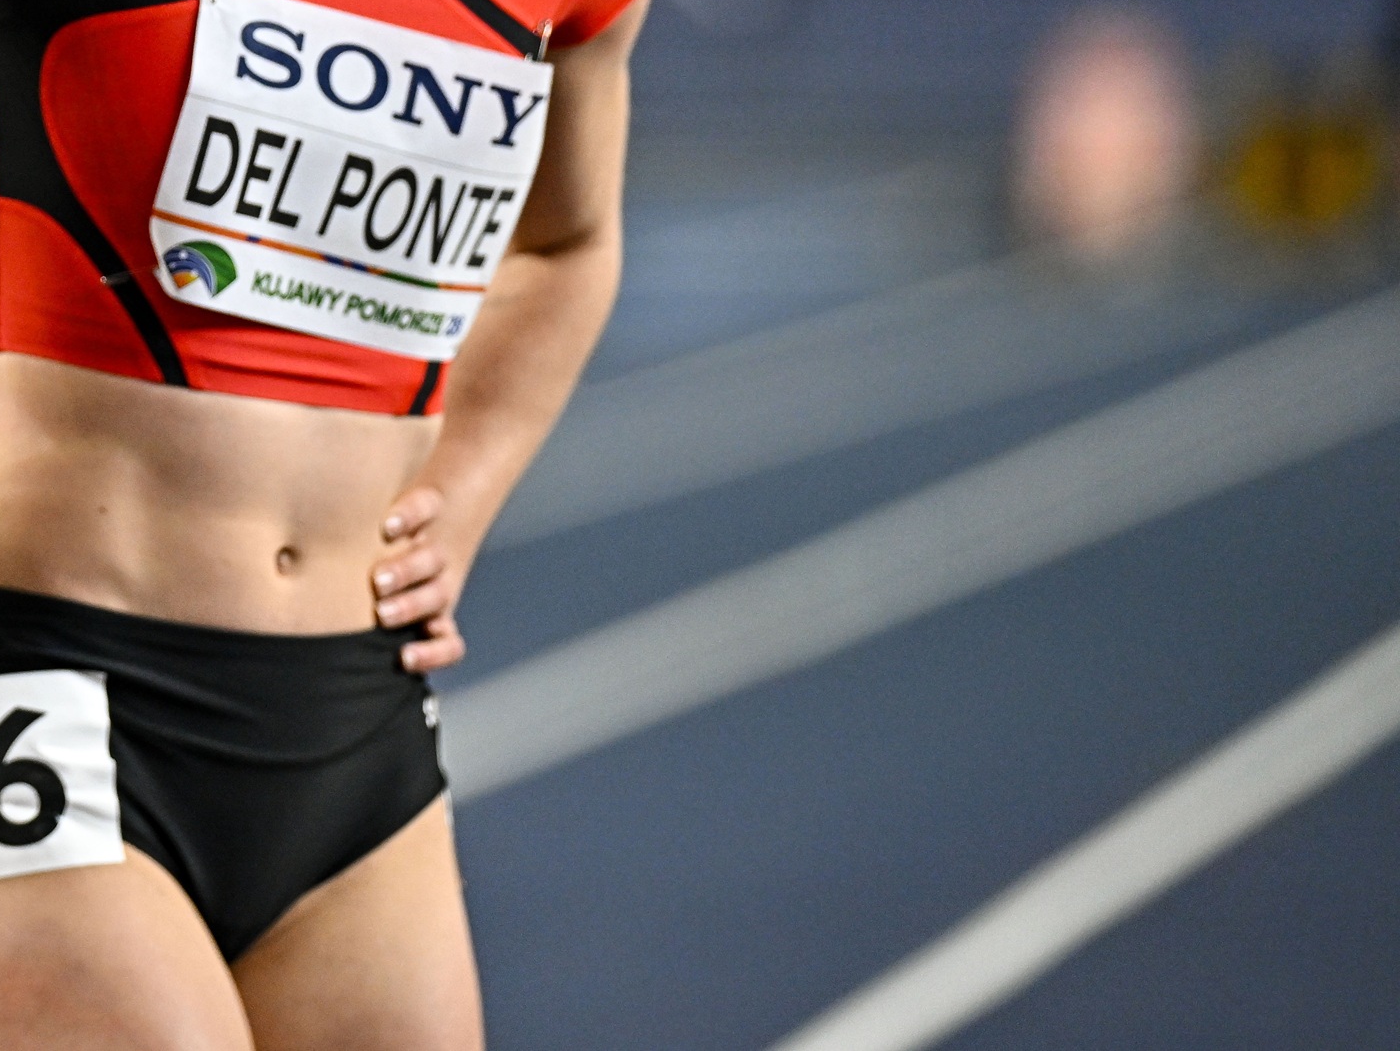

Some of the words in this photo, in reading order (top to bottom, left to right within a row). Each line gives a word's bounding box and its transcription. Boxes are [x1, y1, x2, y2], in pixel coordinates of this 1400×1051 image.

[236, 21, 546, 148] SONY
[185, 116, 304, 230] DEL
[318, 153, 517, 270] PONTE
[251, 271, 344, 312] KUJAWY
